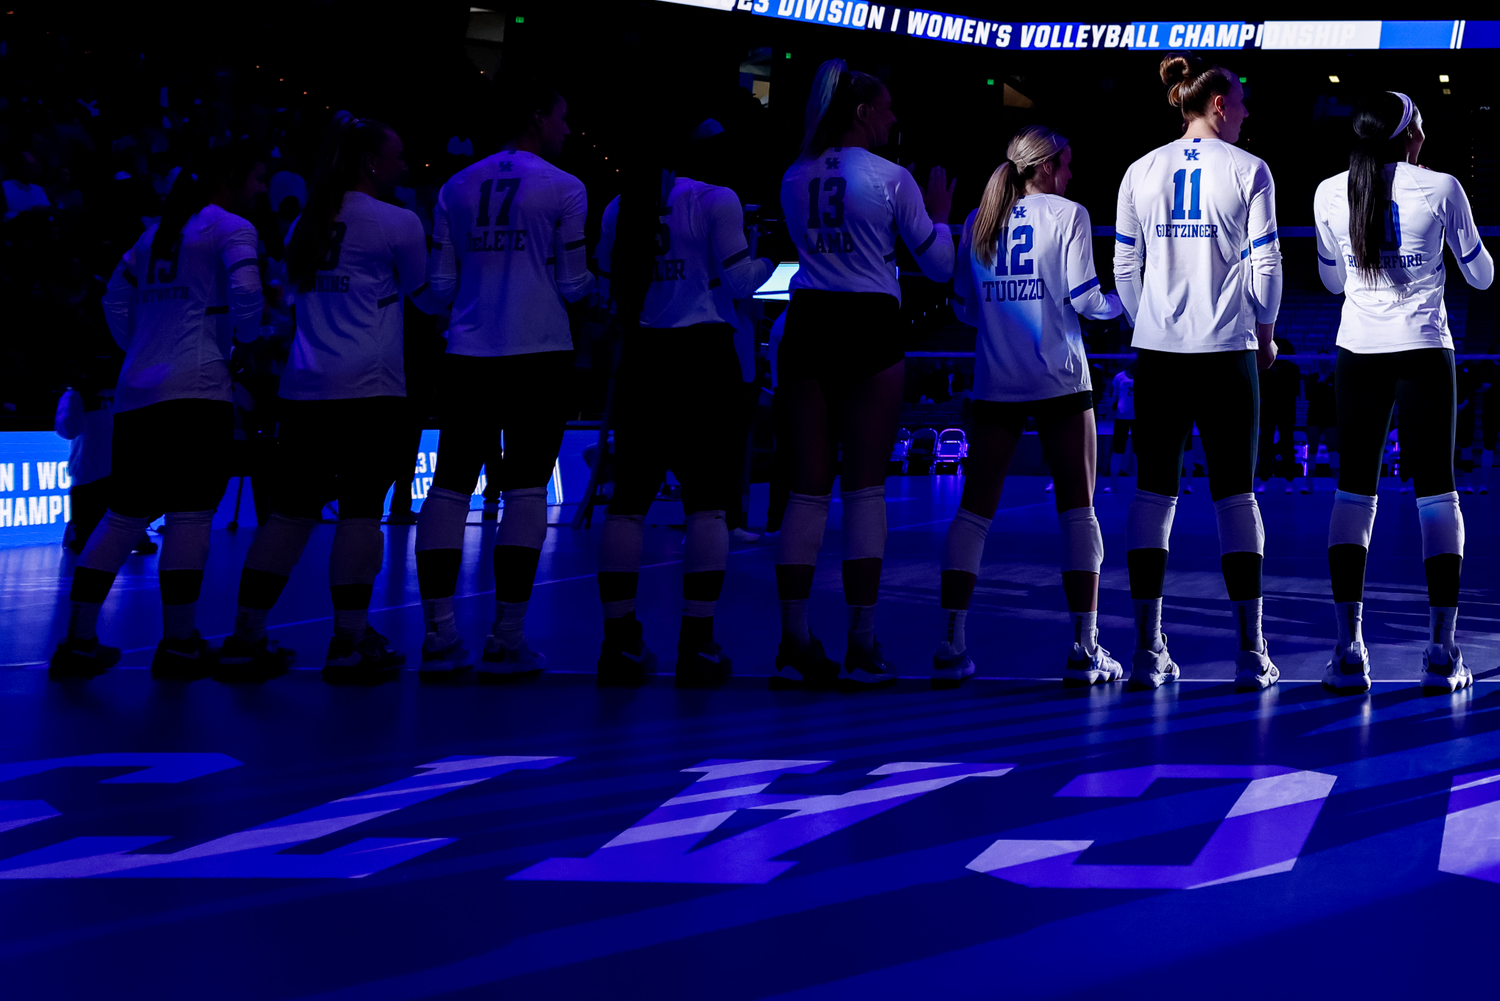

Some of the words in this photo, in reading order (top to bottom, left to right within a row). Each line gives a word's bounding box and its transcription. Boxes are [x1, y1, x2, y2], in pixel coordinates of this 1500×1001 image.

[891, 8, 900, 31] I
[907, 11, 1011, 48] WOMEN'S
[1020, 24, 1160, 48] VOLLEYBALL
[1168, 23, 1356, 48] CHAMPIONSHIP
[476, 177, 521, 227] 17
[807, 177, 847, 229] 13
[1172, 168, 1202, 220] 11
[804, 232, 854, 254] LAMB
[995, 225, 1034, 276] 12
[982, 278, 1045, 302] TUOZZO
